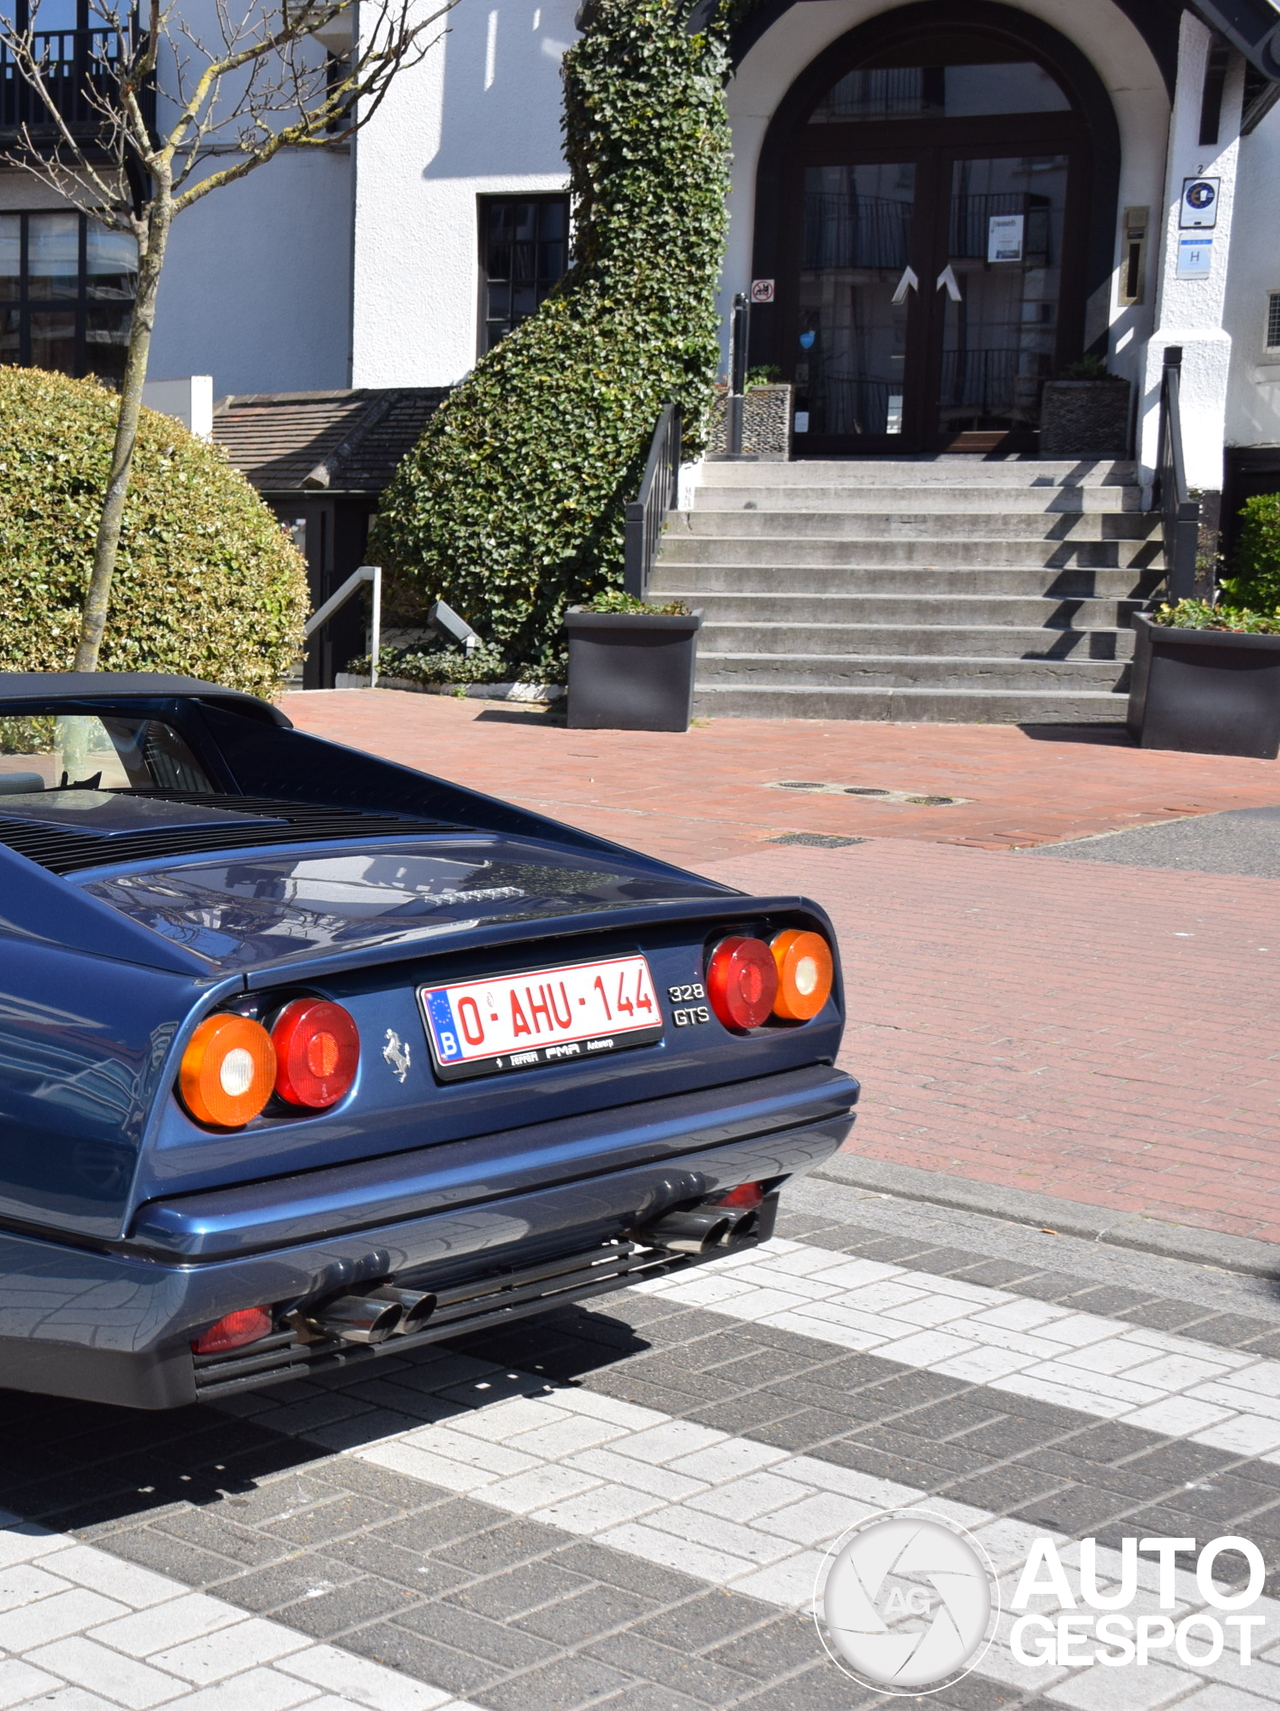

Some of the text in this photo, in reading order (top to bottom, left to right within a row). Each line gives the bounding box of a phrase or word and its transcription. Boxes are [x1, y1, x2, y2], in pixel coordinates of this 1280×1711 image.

[1197, 164, 1204, 175] 2
[1190, 251, 1200, 262] H
[668, 983, 705, 1002] 328
[673, 1006, 710, 1026] GTS
[440, 1032, 457, 1056] B
[509, 1051, 539, 1066] Ferrari
[586, 1038, 614, 1051] Antwerp
